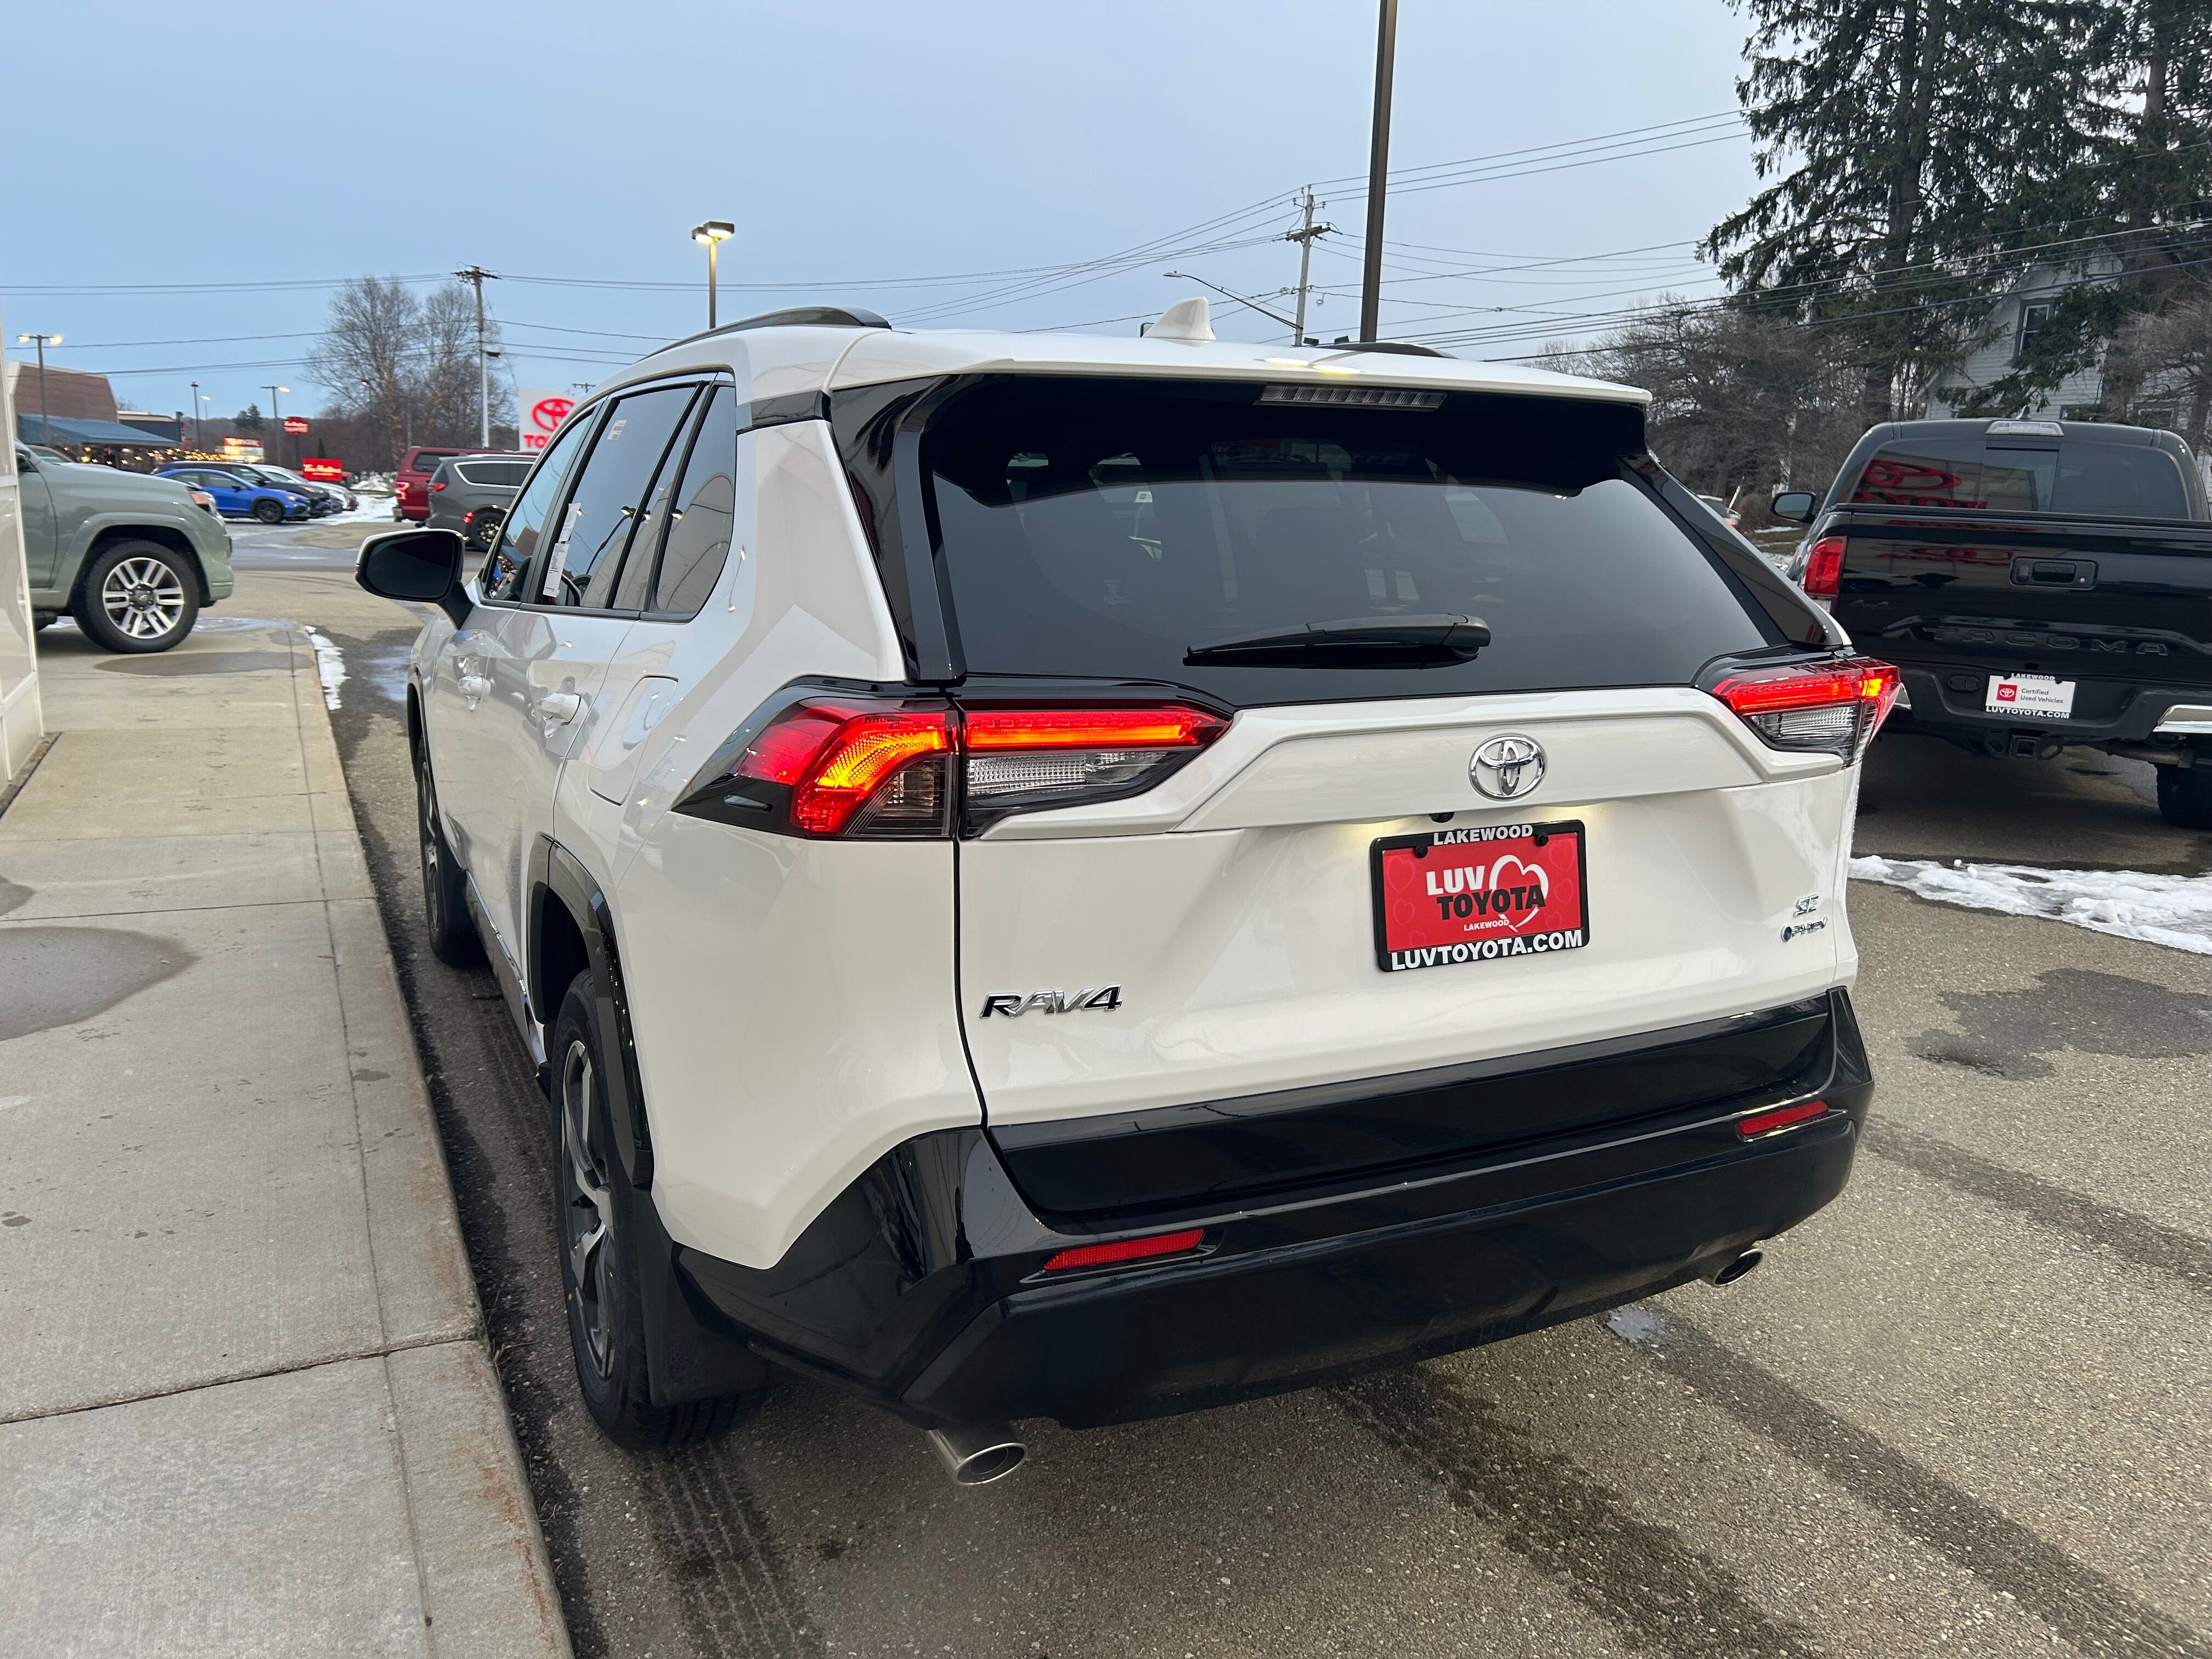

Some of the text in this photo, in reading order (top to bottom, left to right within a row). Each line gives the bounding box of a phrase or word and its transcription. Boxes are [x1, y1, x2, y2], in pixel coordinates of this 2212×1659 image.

[523, 433, 551, 448] TO
[1922, 627, 2169, 656] TACOMA
[2011, 673, 2055, 681] LAKEWOOD
[1985, 706, 2070, 719] LUVTOYOTA.COM
[1433, 825, 1533, 845] LAKEWOOD
[1426, 865, 1485, 896] LUV
[1437, 884, 1546, 920] TOYOTA
[1463, 919, 1510, 932] LAKEWOOD
[1391, 929, 1583, 971] LUVTOYOTA.COM
[979, 984, 1123, 1019] RAV4
